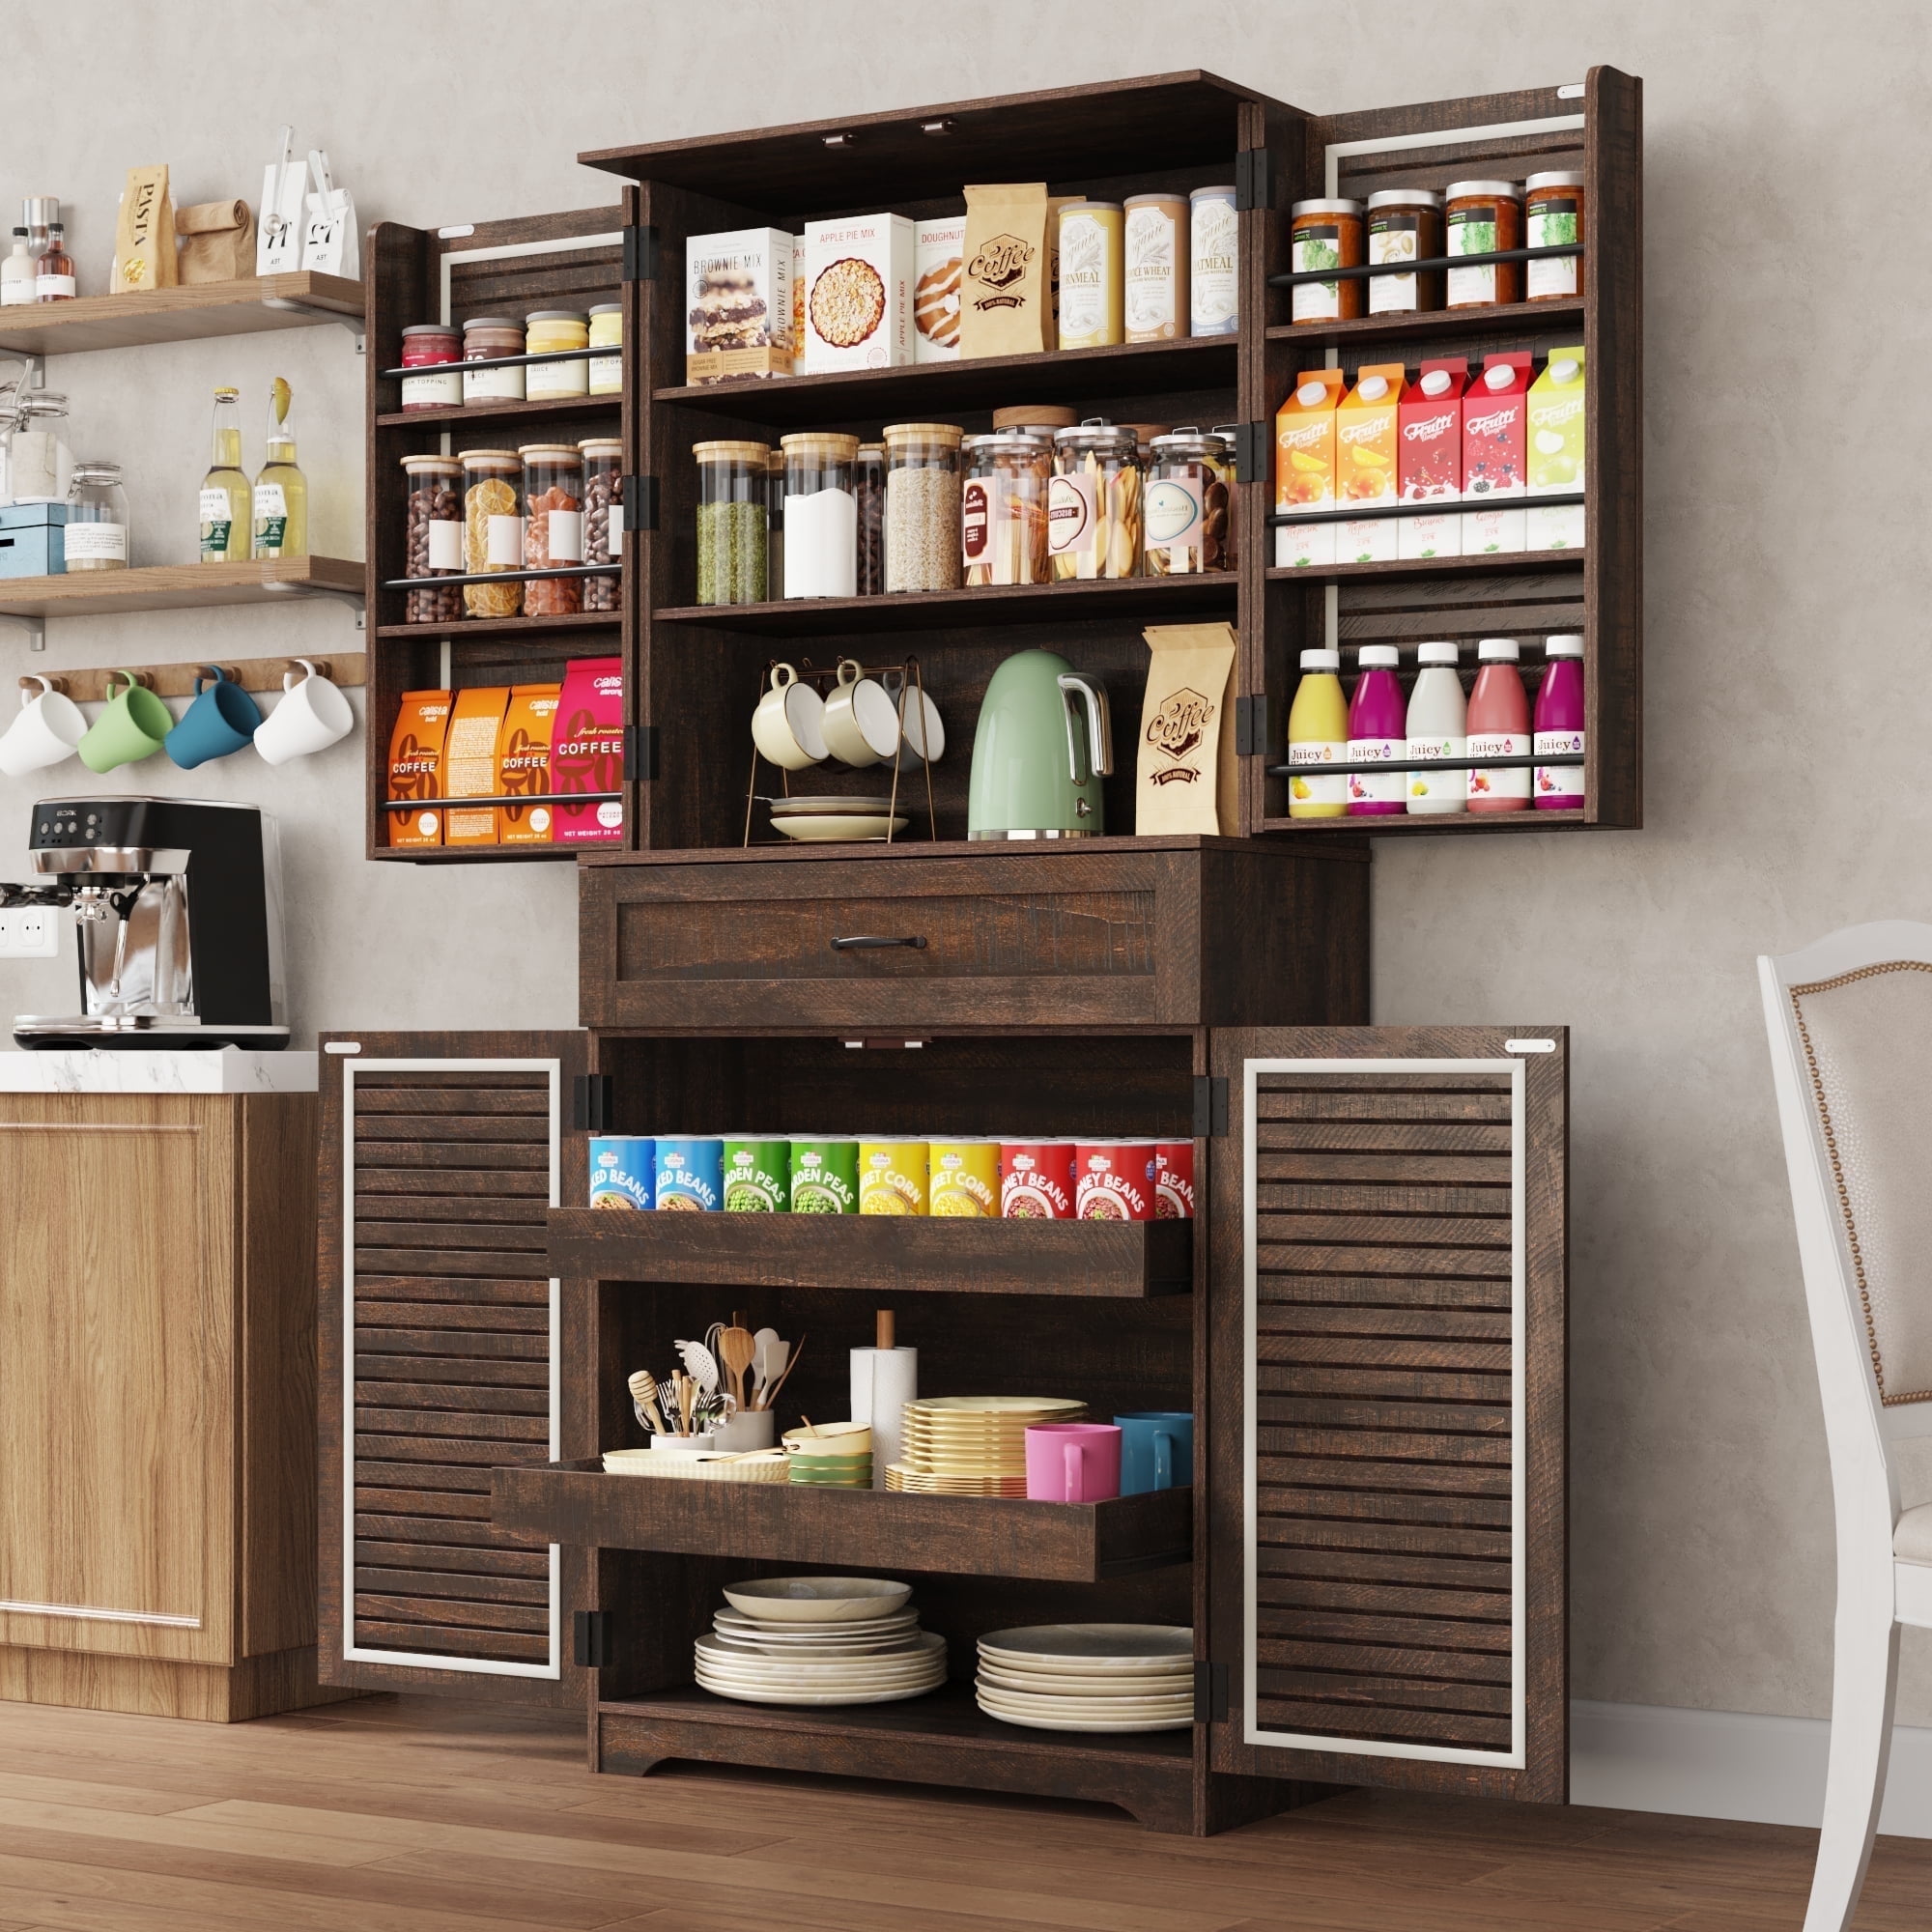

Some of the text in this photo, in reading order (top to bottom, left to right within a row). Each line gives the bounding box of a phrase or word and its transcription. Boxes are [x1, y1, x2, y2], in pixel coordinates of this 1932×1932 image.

[135, 184, 155, 246] PASTA
[820, 228, 875, 243] APPLE PIE MIX
[922, 229, 964, 243] DOUGHNUT
[694, 254, 762, 274] BROWNIE MIX
[968, 244, 1036, 277] Coffee
[1143, 266, 1172, 276] WHEAT
[777, 260, 786, 342] BROWNIE MIX
[1279, 422, 1329, 448] Frutti
[1340, 416, 1391, 443] Frutti
[1404, 415, 1454, 441] Frutti
[1465, 410, 1517, 436] Frutti
[574, 726, 597, 738] fresh
[1147, 702, 1215, 743] Coffee
[404, 749, 419, 758] fresh
[514, 743, 532, 753] fresh
[558, 741, 622, 755] COFFEE
[1291, 749, 1322, 761] Juicy
[1351, 747, 1381, 758] Juicy
[1410, 745, 1441, 757] Juicy
[1471, 742, 1502, 754] Juicy
[1538, 739, 1571, 752] Juicy
[392, 761, 436, 774] COFFEE
[502, 756, 548, 769] COFFEE
[610, 1169, 649, 1206] BEANS
[676, 1170, 716, 1207] BEANS
[754, 1168, 785, 1205] PEAS
[823, 1169, 854, 1206] PEAS
[884, 1170, 922, 1204] CORN
[955, 1171, 994, 1206] CORN
[1028, 1172, 1068, 1211] BEANS
[1110, 1172, 1145, 1212] BEANS
